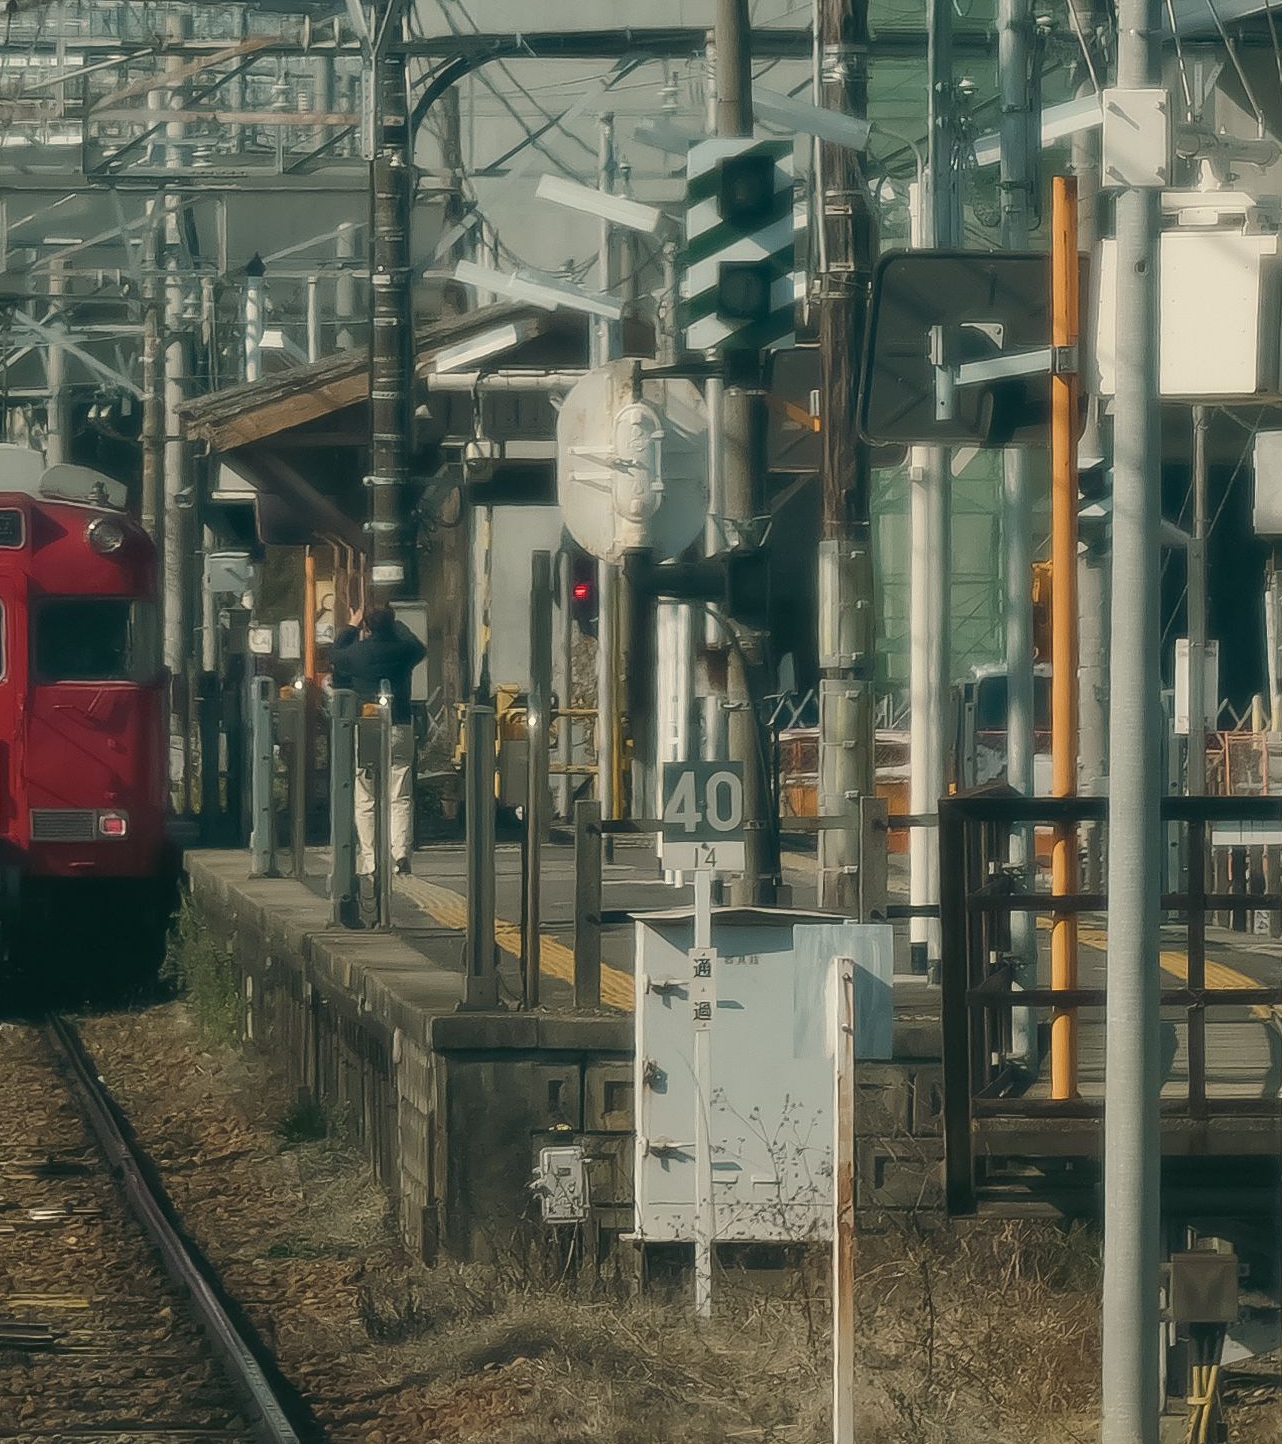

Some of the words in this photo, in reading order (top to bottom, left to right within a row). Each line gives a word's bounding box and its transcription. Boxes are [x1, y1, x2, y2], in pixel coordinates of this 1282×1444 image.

[663, 771, 743, 833] 40
[694, 847, 717, 868] 14
[692, 958, 712, 1021] 通過
